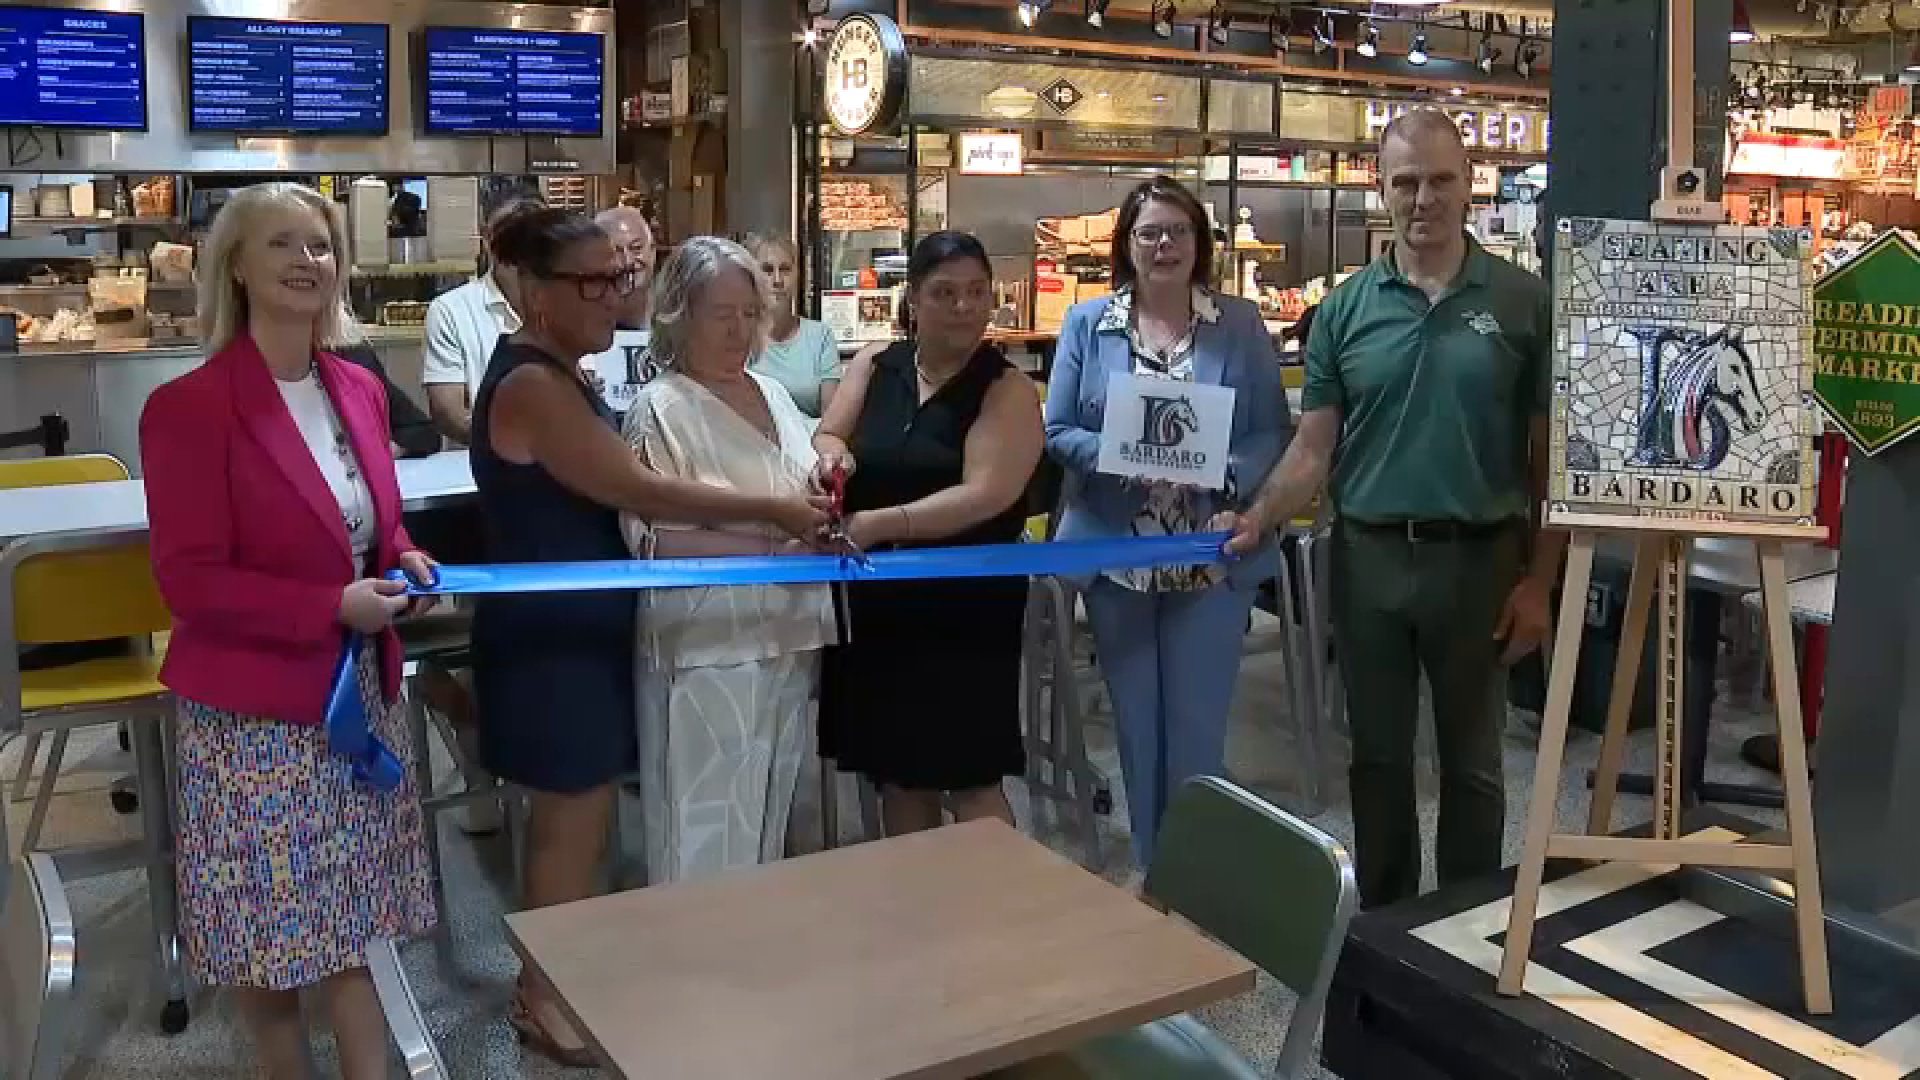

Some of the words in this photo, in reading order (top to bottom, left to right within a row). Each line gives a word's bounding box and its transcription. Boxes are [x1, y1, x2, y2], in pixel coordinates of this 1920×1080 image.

[1365, 101, 1528, 150] HGER
[1814, 327, 1919, 357] ERMIN
[1571, 473, 1797, 512] BARDARO
